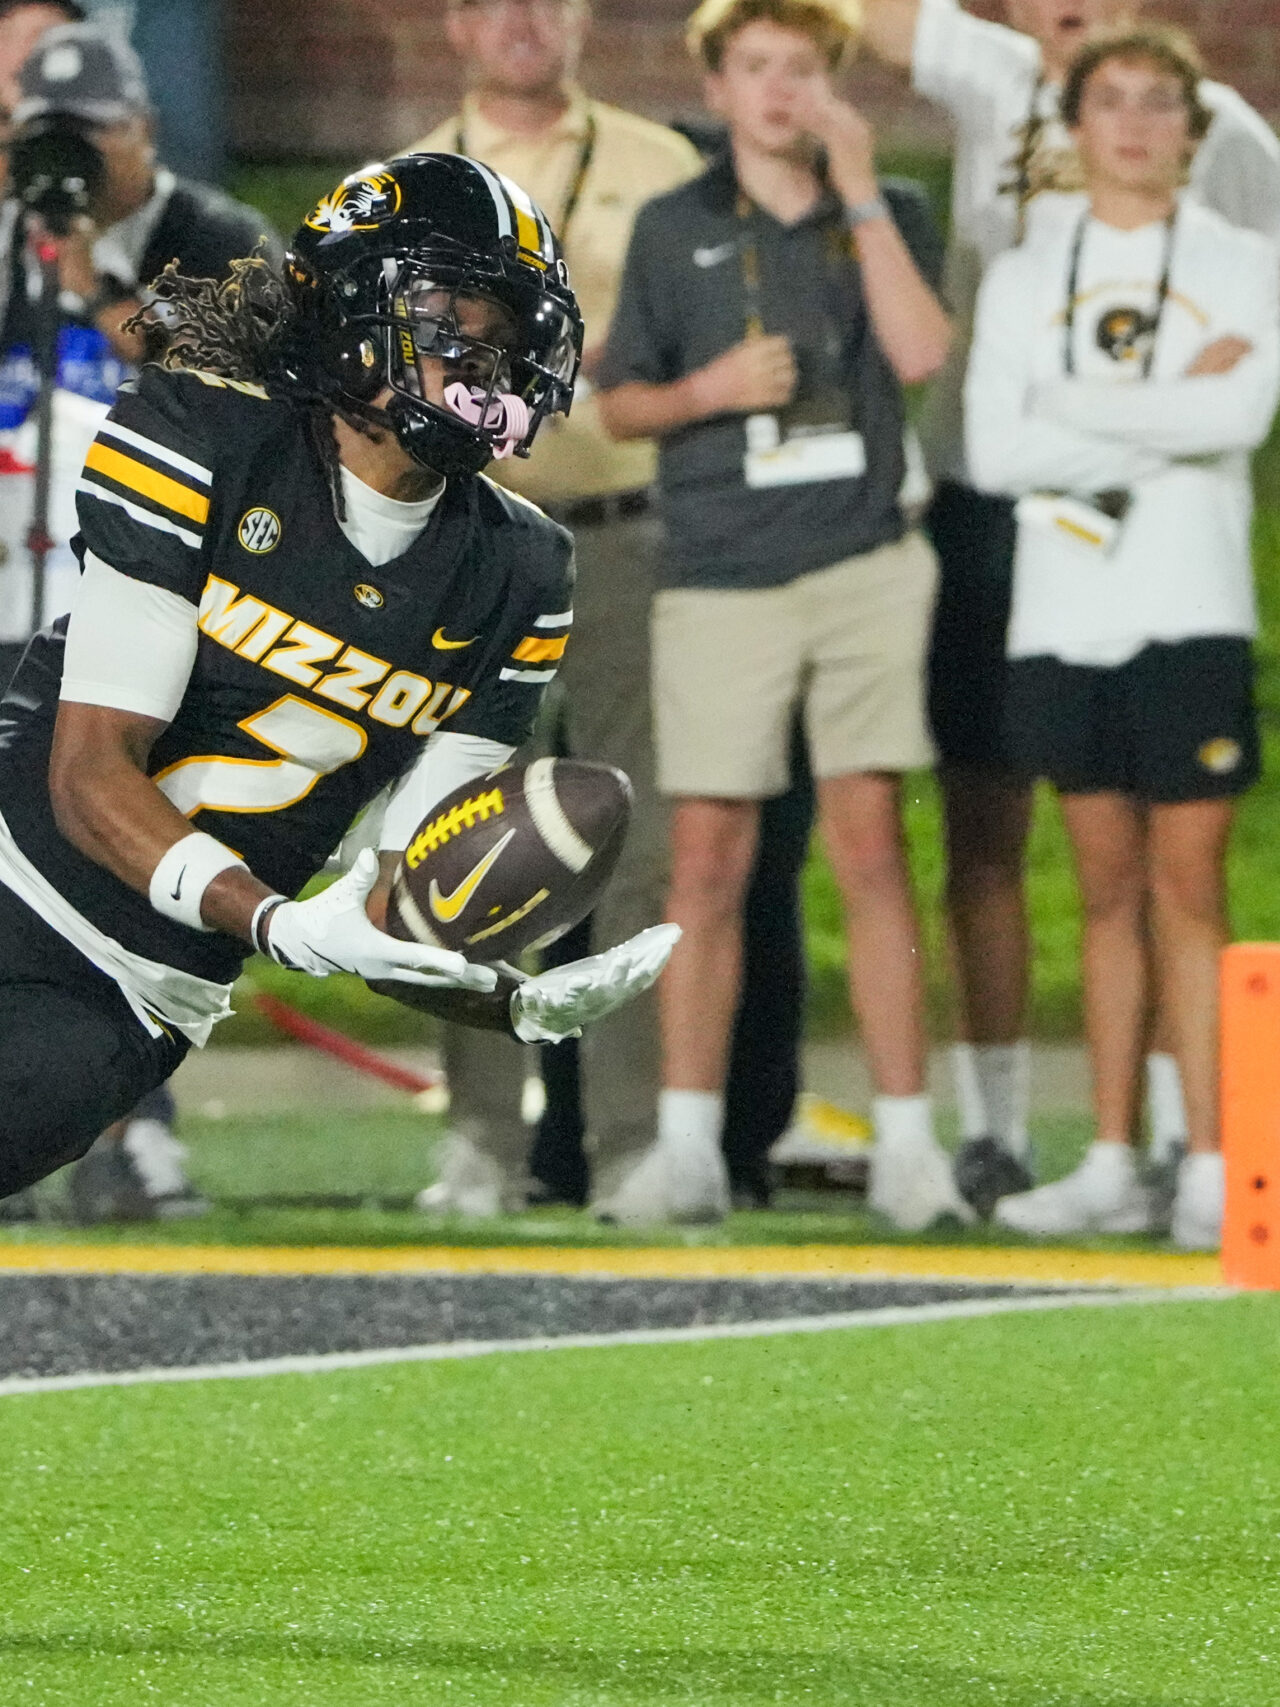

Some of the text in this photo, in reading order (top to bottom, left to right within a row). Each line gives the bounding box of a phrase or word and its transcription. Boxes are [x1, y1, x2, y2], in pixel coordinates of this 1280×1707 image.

[241, 511, 278, 550] SEC
[197, 573, 472, 735] MIZZOU
[152, 693, 368, 857] 2
